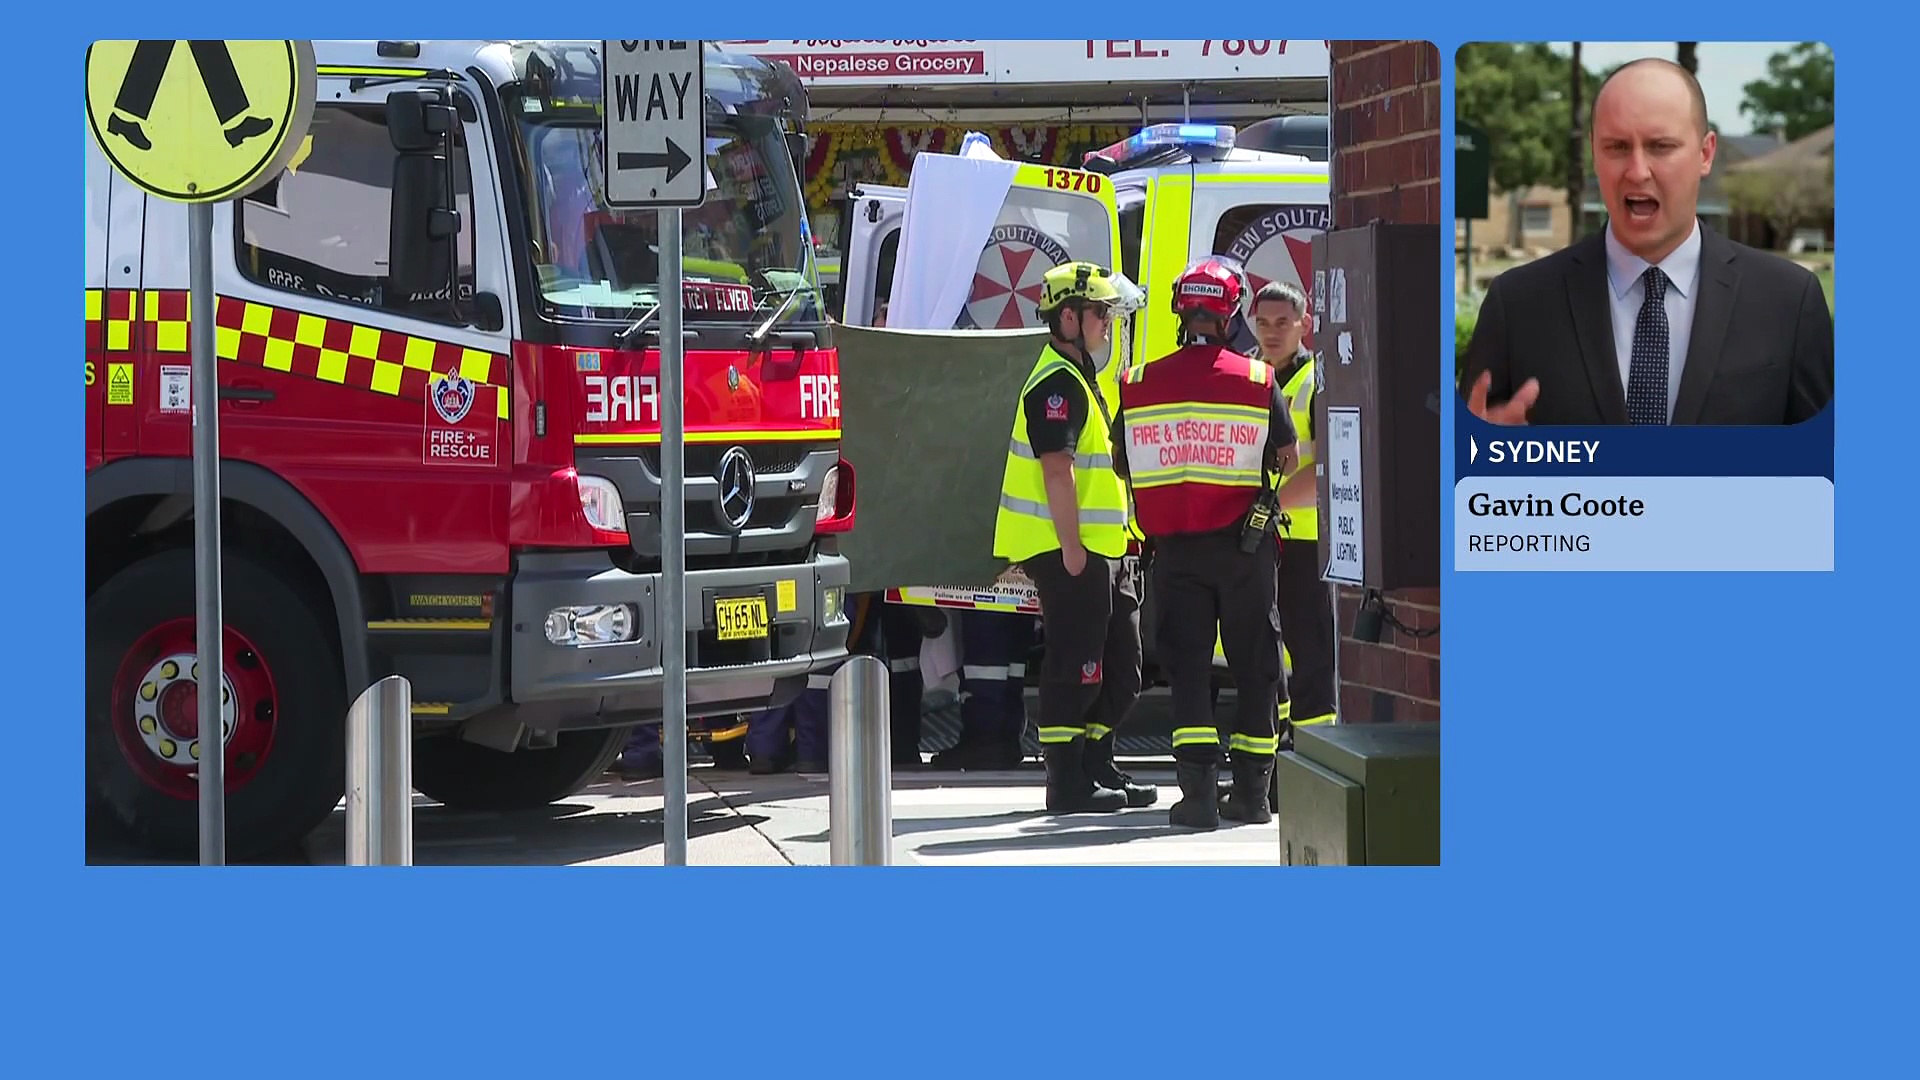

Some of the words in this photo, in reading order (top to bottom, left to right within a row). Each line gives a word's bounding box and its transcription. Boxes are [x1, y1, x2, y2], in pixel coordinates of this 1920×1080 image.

[797, 54, 889, 74] Nepalese
[895, 54, 975, 72] Grocery
[615, 72, 692, 121] WAY
[1043, 168, 1101, 193] 1370
[1231, 229, 1261, 260] EW
[1262, 208, 1330, 235] SOUTH
[799, 374, 840, 419] FIRE
[431, 430, 464, 444] FIRE
[1132, 424, 1161, 447] FIRE
[1164, 423, 1174, 443] &
[1176, 421, 1225, 443] RESCUE
[1229, 424, 1259, 446] NSW
[430, 444, 490, 459] RESCUE
